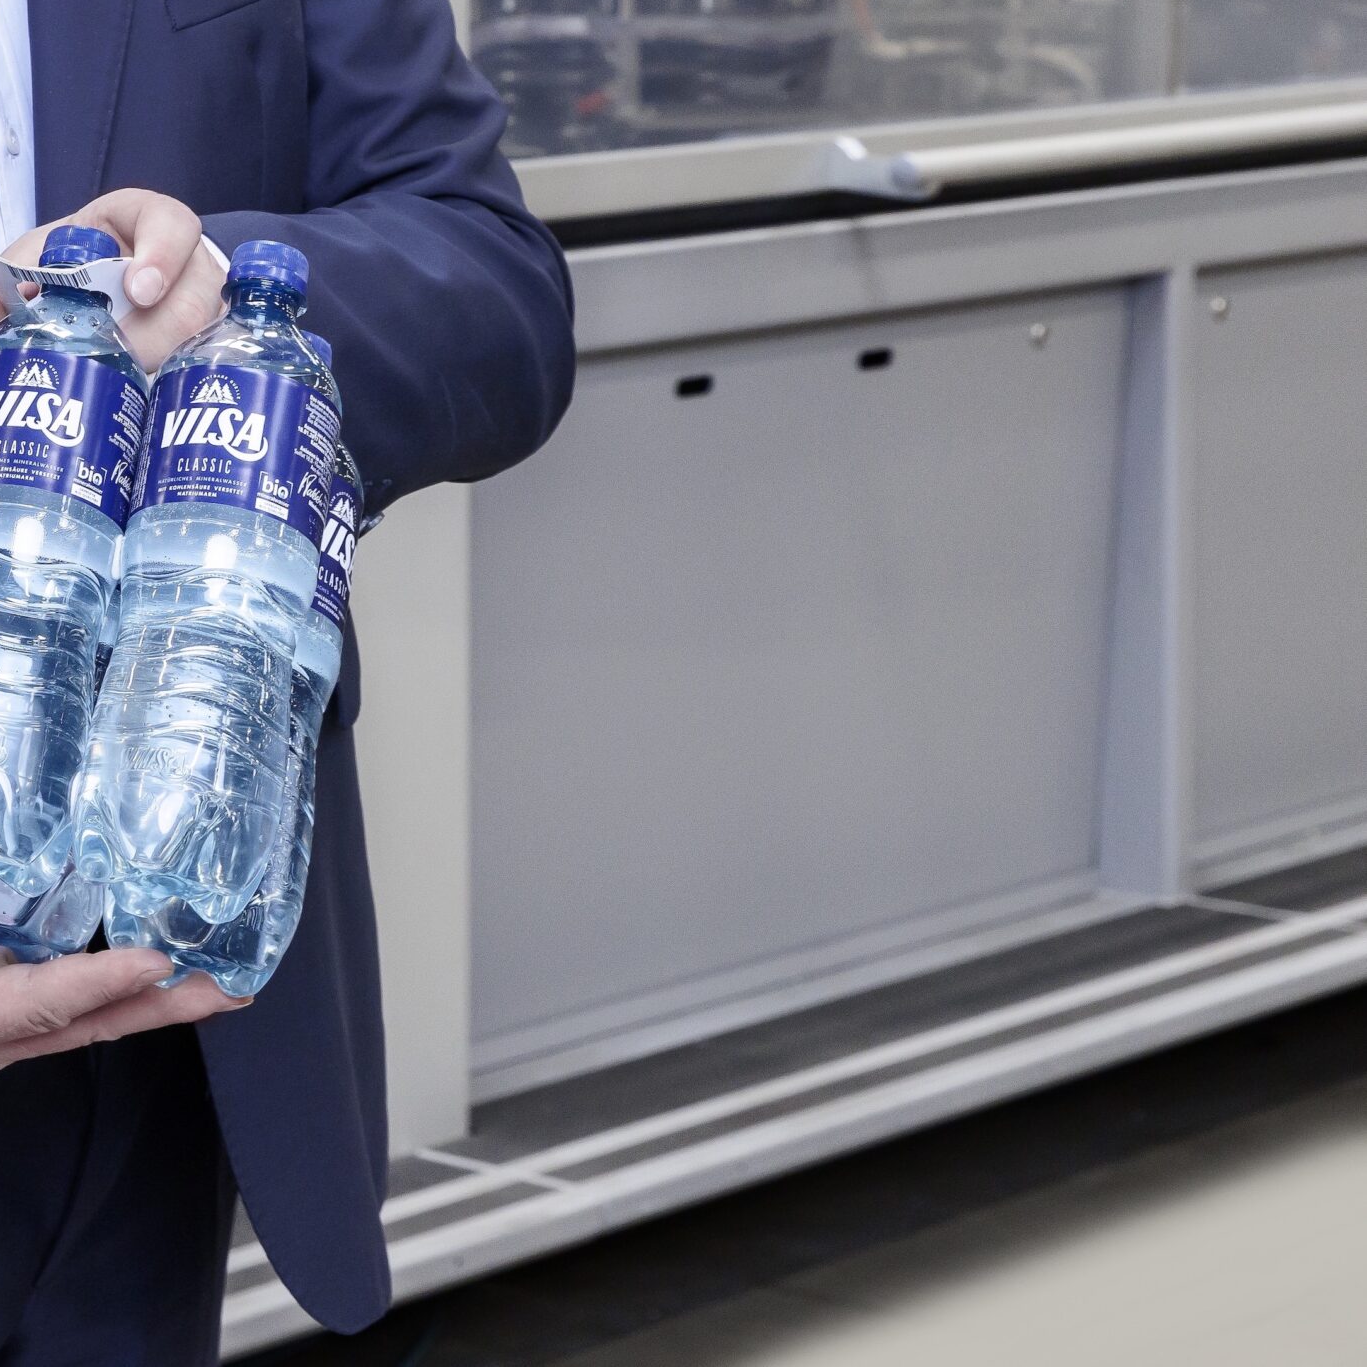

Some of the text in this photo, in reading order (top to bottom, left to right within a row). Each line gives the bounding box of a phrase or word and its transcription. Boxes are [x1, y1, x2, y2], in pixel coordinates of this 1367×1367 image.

[161, 408, 268, 462] VILSA
[78, 461, 103, 486] bio
[177, 458, 232, 474] CLASSIC
[262, 475, 289, 499] bio
[321, 517, 356, 589] ILS
[318, 566, 347, 600] CLASSIC
